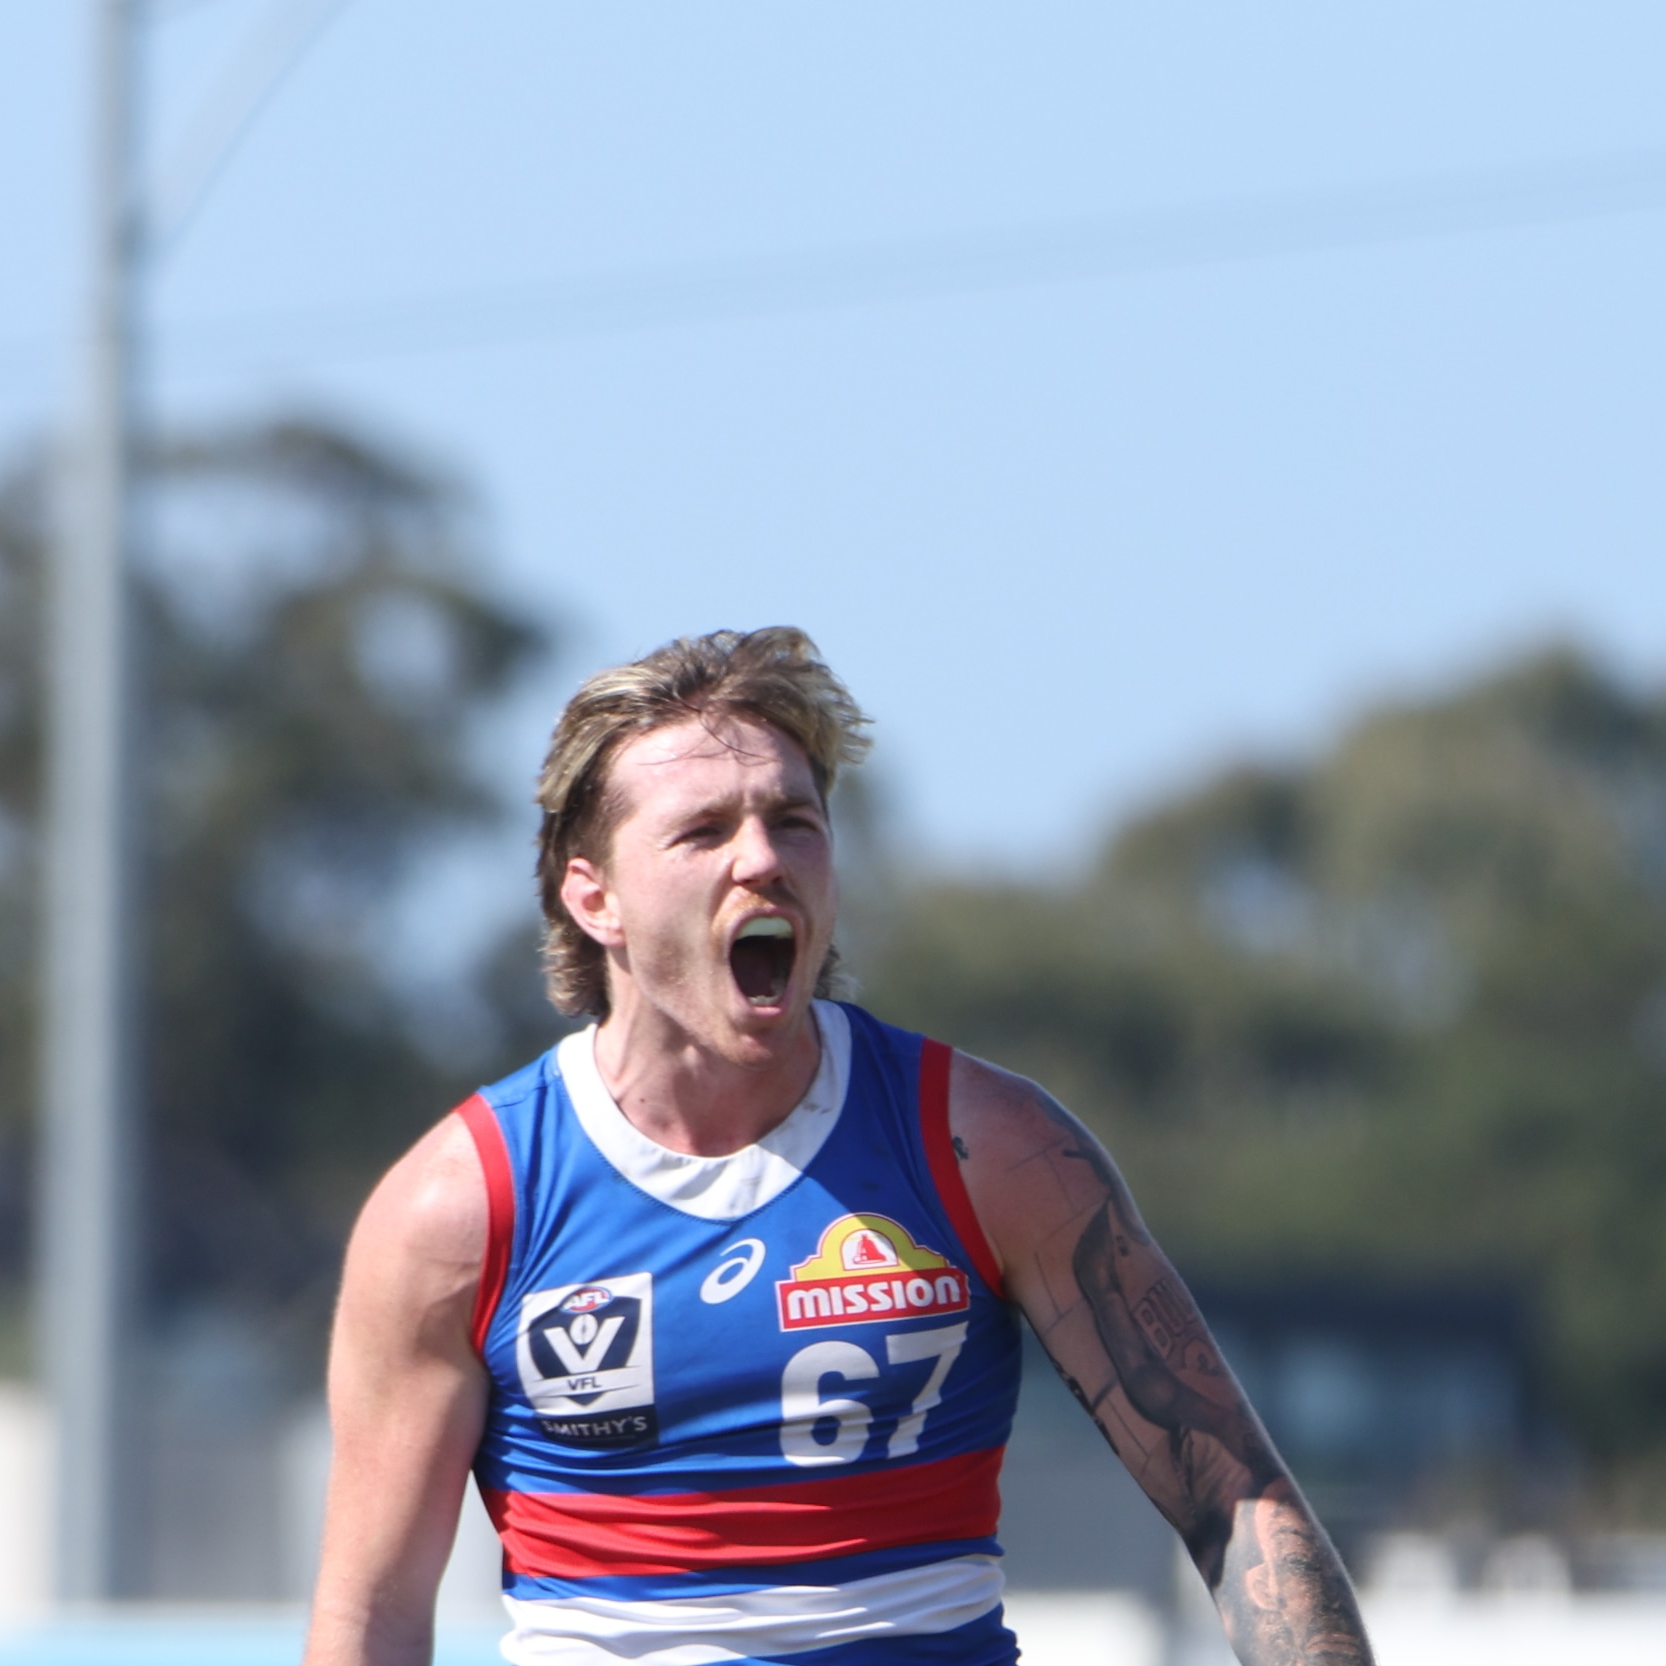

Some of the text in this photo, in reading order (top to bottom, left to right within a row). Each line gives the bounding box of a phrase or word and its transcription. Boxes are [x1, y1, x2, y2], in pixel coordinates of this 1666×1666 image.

[566, 1376, 603, 1392] VFL
[779, 1320, 970, 1468] 67
[540, 1415, 648, 1437] SMITHY'S
